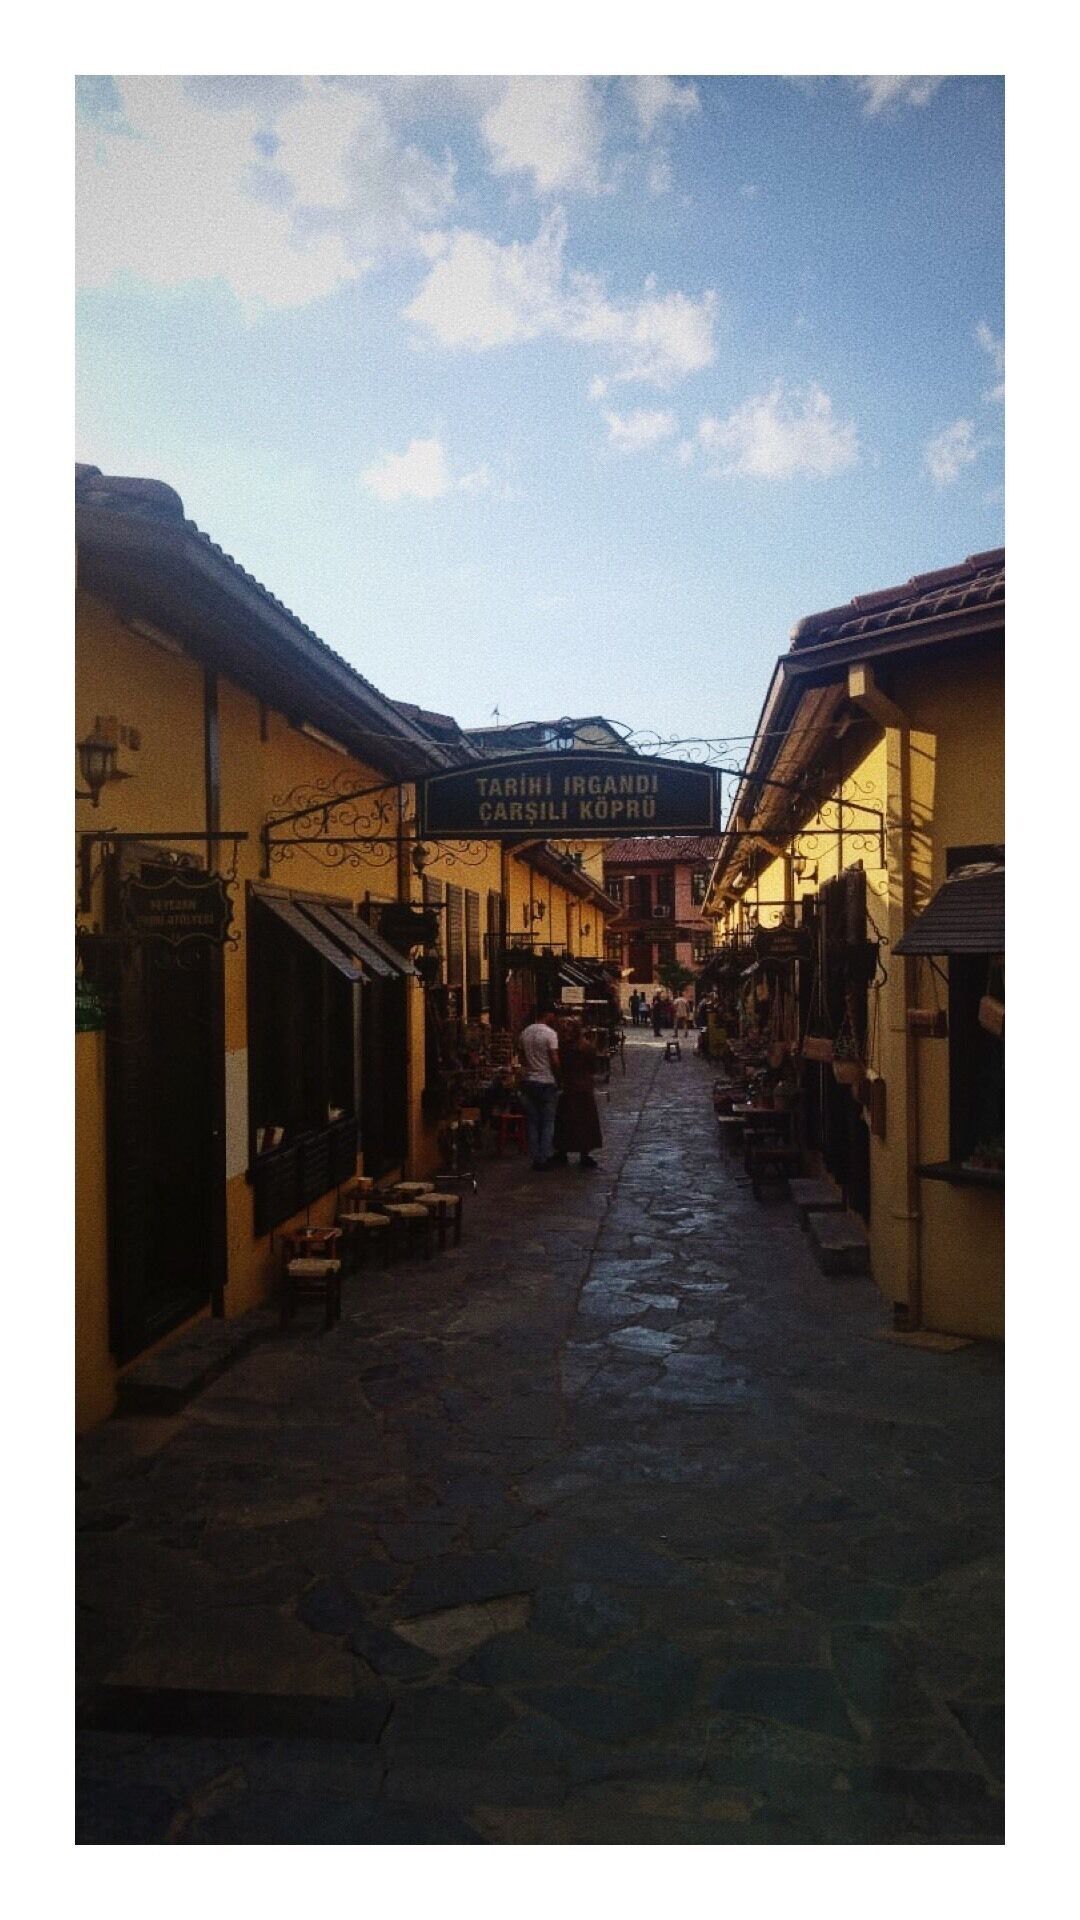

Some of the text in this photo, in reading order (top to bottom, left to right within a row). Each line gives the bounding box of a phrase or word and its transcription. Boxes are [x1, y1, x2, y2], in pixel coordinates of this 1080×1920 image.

[475, 772, 659, 797] TARİHİ IRGANDI
[478, 796, 656, 825] ÇARŞILI KÖPRÜ
